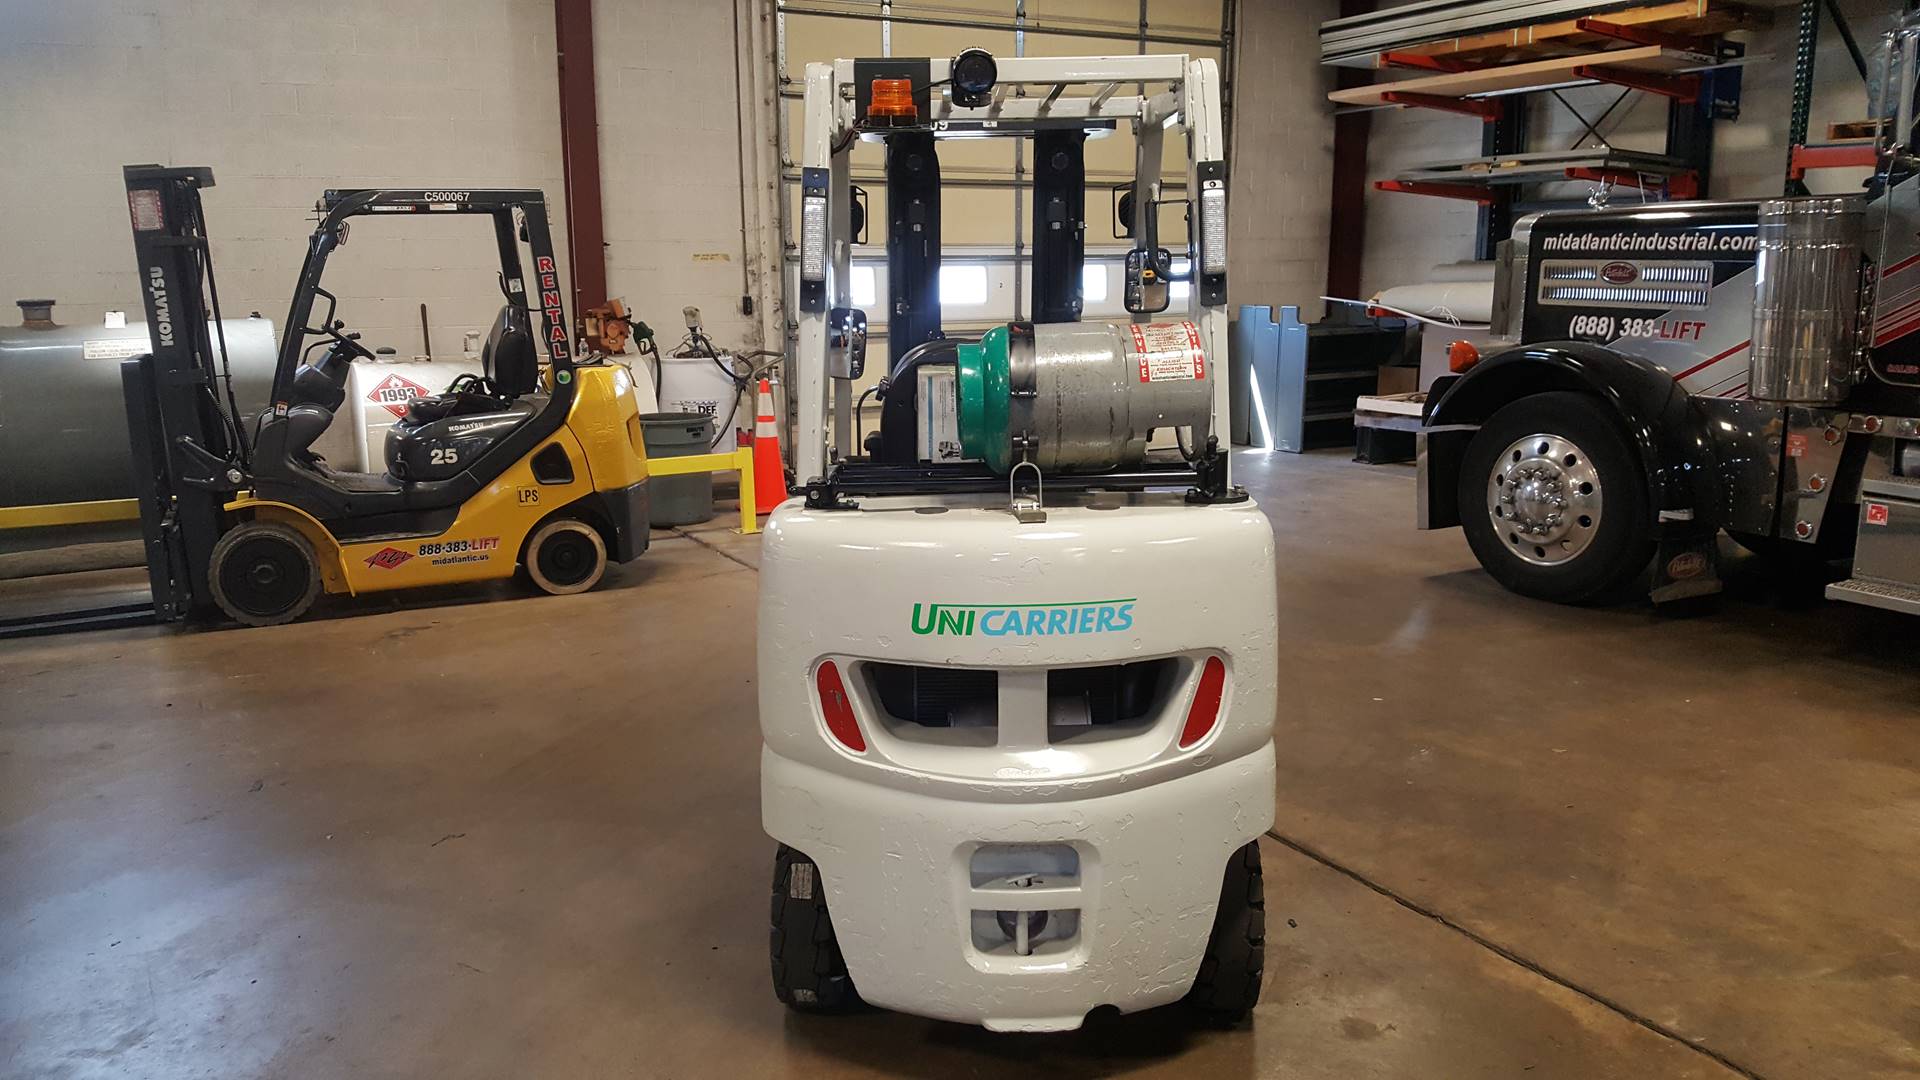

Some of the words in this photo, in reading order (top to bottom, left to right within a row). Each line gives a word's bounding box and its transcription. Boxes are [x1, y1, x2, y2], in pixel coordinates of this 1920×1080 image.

[424, 192, 470, 202] C500067
[1543, 232, 1759, 250] midatlanticindustrial.com
[149, 266, 174, 347] KOMATSU
[537, 256, 568, 359] RENTAL
[1569, 315, 1615, 341] (888)
[1619, 317, 1706, 340] 383-LIFT
[381, 387, 417, 402] 1993
[399, 404, 406, 413] 3
[448, 422, 484, 432] KOMATSU
[430, 448, 459, 465] 25
[518, 489, 539, 503] LPS
[432, 554, 489, 566] midatlantic.us
